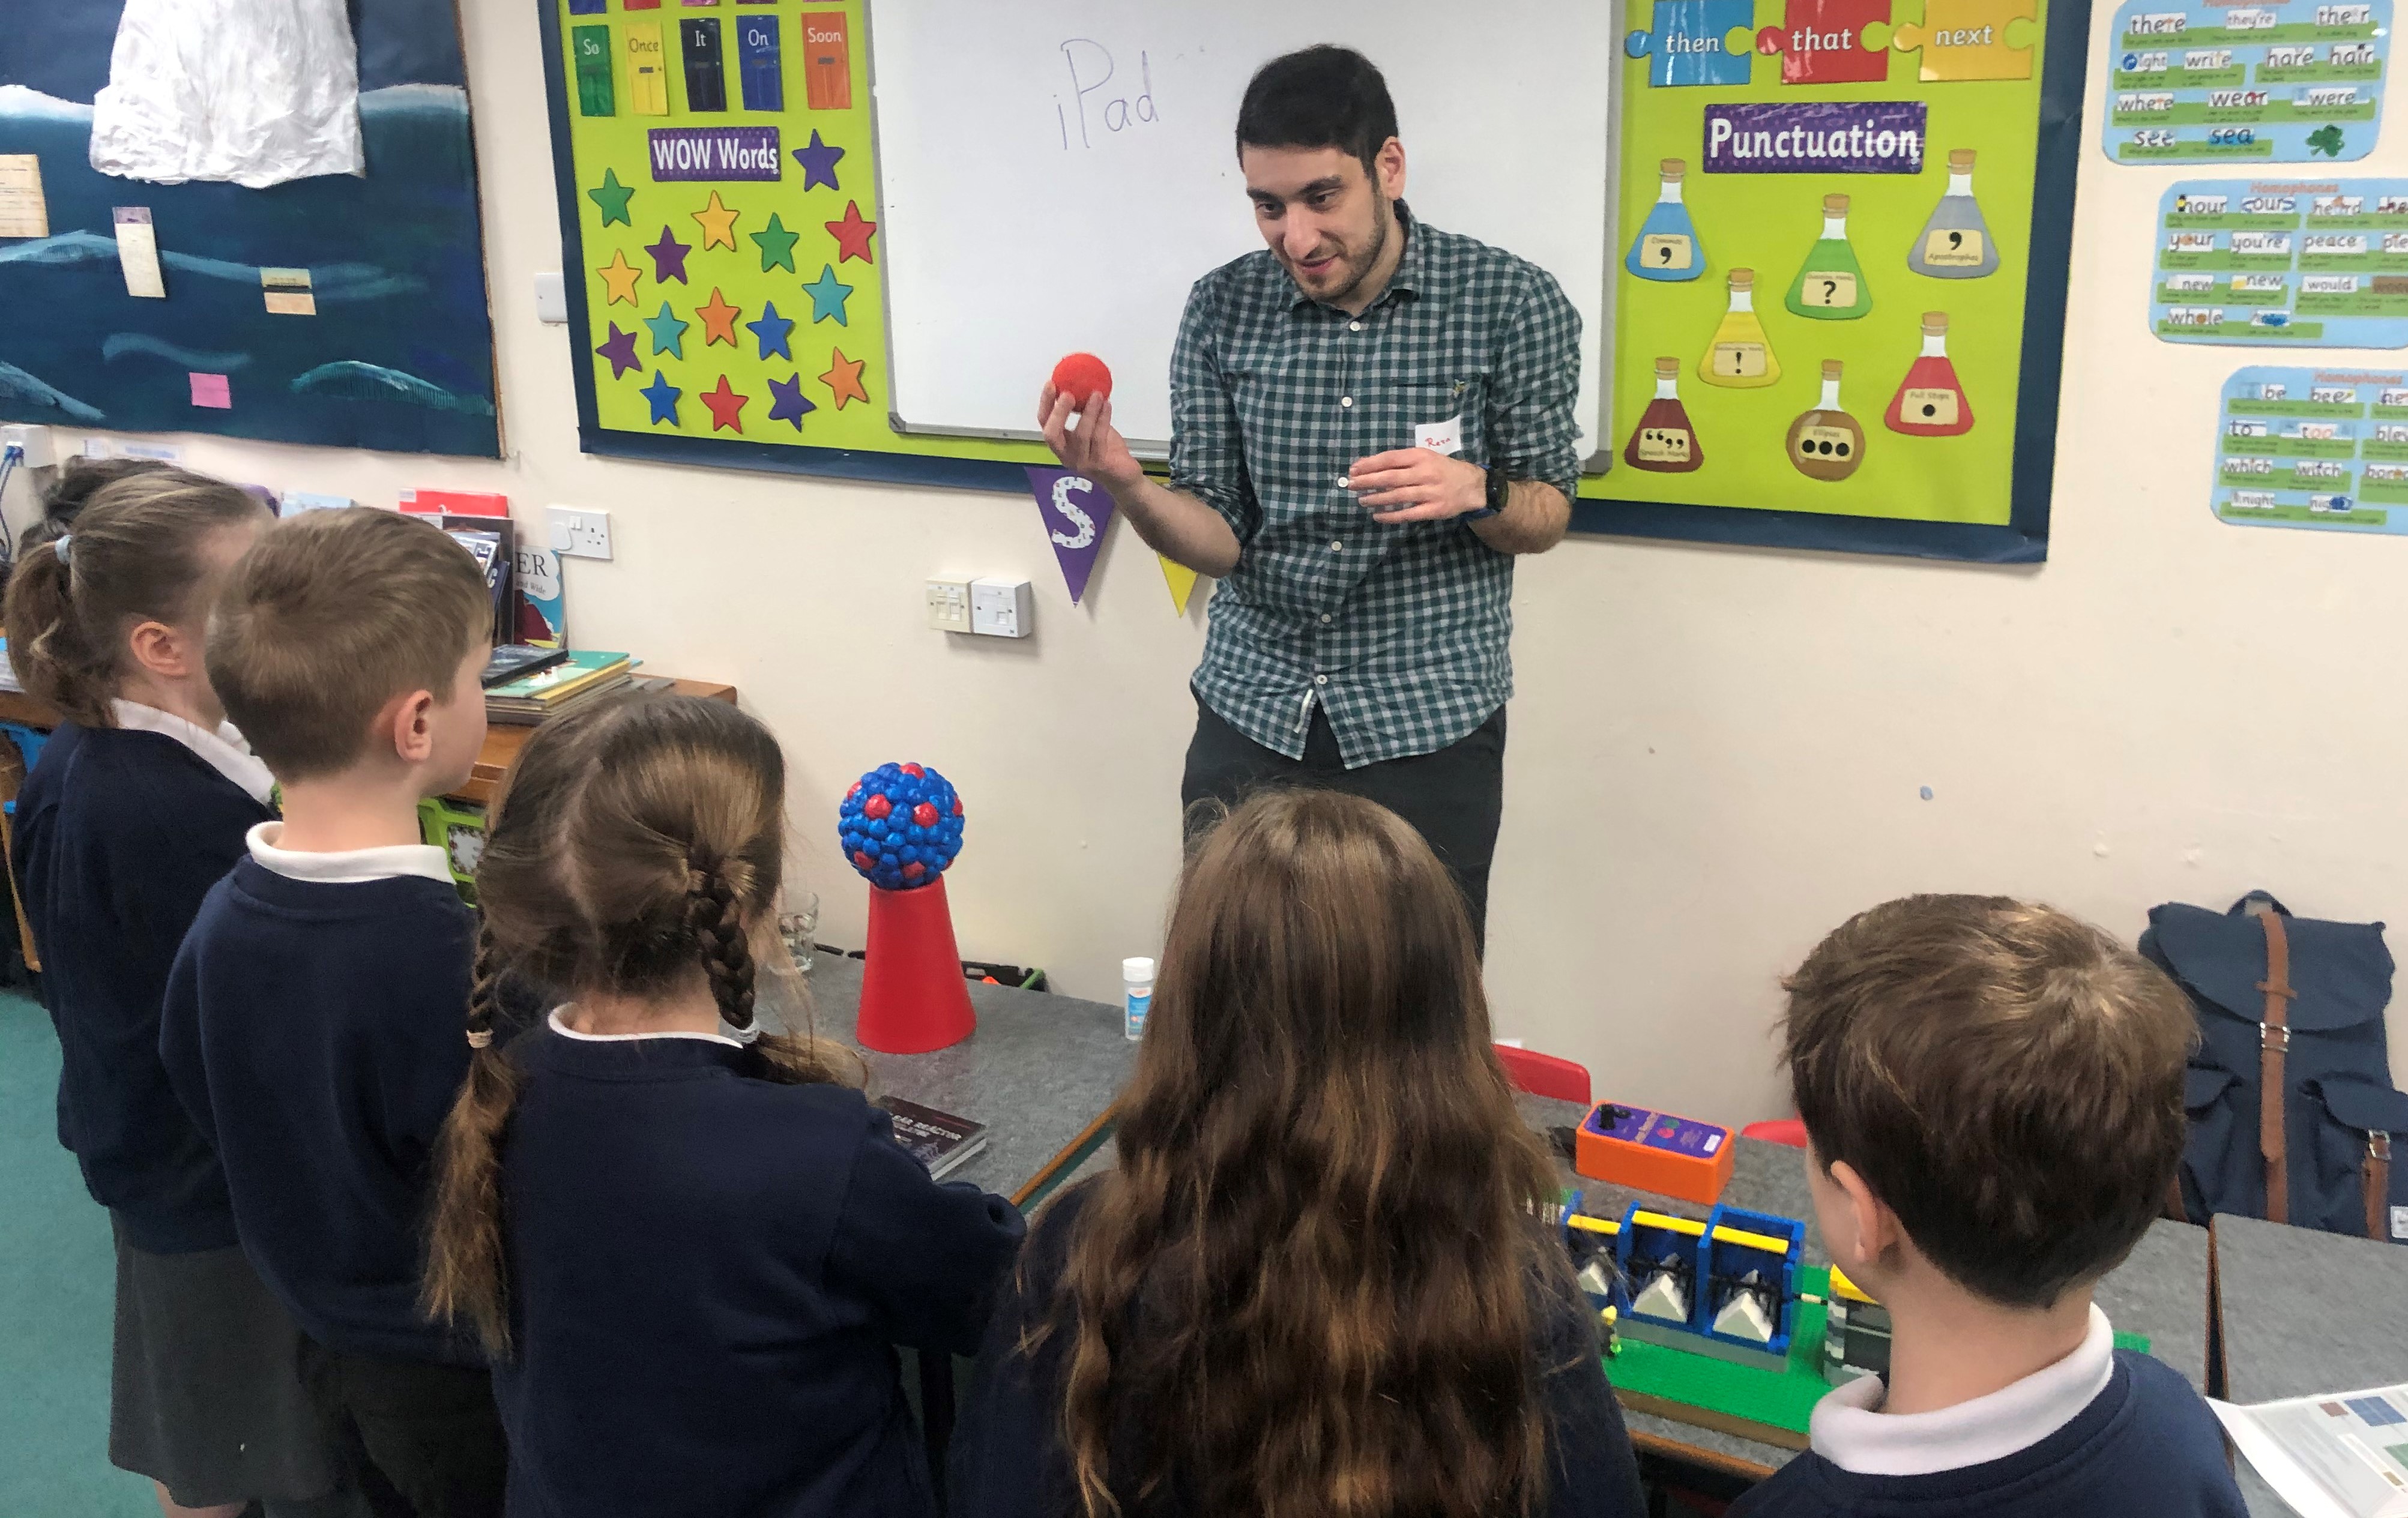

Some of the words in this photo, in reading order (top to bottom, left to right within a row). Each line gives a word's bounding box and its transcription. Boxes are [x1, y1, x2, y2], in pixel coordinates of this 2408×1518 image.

[2131, 14, 2186, 34] there
[695, 30, 707, 47] It
[747, 29, 770, 48] On
[807, 27, 842, 44] Soon
[1665, 34, 1721, 54] then
[1792, 28, 1853, 52] that
[1934, 25, 1993, 47] next
[583, 39, 600, 56] So
[629, 37, 659, 53] Once
[2185, 51, 2232, 68] write
[2266, 48, 2314, 67] hare
[2330, 44, 2374, 65] hair
[1052, 38, 1160, 150] iPad
[2119, 94, 2174, 112] where
[2212, 92, 2268, 108] wear
[2309, 92, 2356, 106] were
[1710, 118, 1921, 158] Punctuation
[2134, 131, 2174, 146] see
[2210, 128, 2254, 145] sea
[653, 138, 711, 170] WOW
[717, 137, 779, 170] Words
[2231, 236, 2283, 255] you're
[2304, 236, 2357, 252] peace
[2308, 278, 2352, 291] would
[1051, 476, 1096, 549] S
[530, 582, 547, 595] Wide
